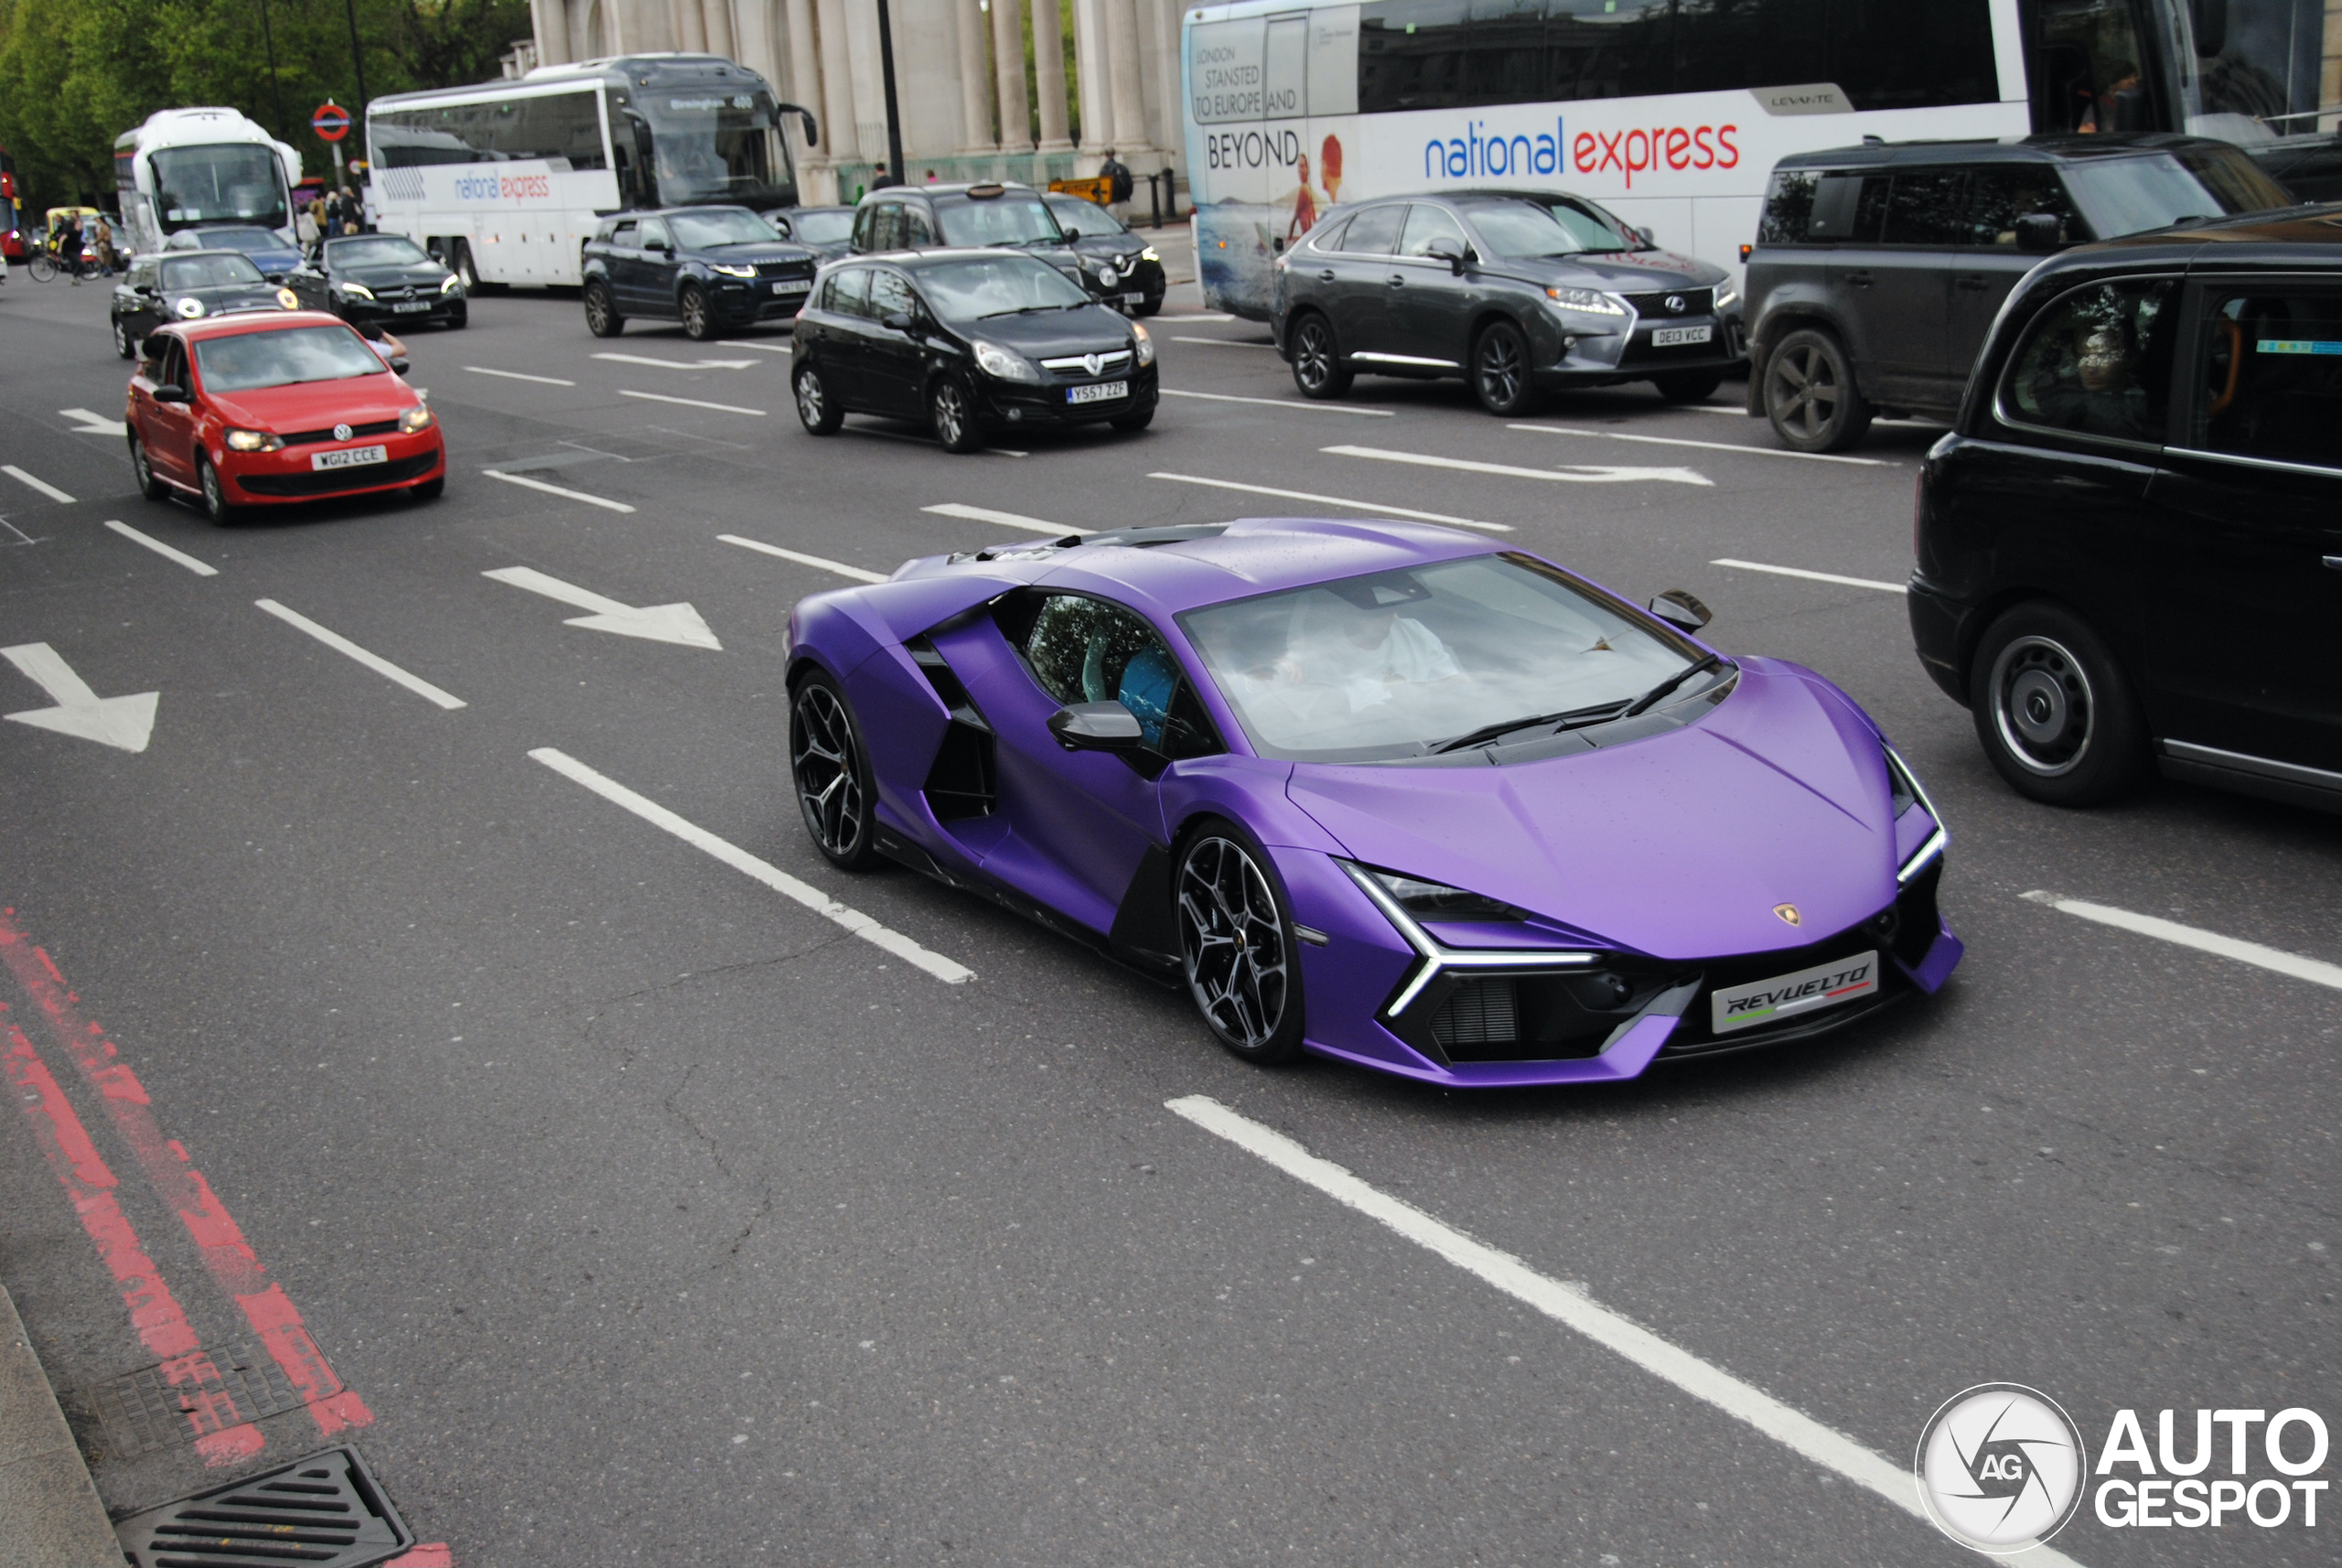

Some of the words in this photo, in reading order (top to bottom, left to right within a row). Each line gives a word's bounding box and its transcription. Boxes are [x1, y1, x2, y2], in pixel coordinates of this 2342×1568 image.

[1197, 47, 1235, 64] LONDON
[1205, 66, 1259, 89] STANSTED
[1196, 95, 1210, 116] TO
[1215, 91, 1261, 115] EUROPE
[1266, 89, 1295, 113] AND
[1771, 93, 1833, 106] LEVANTE
[1209, 130, 1299, 169] BEYOND
[1425, 115, 1563, 177] national
[1574, 124, 1739, 189] express
[500, 175, 549, 207] express
[1659, 330, 1681, 343] DE13
[1685, 328, 1704, 341] VCC
[1074, 385, 1102, 401] YS57
[1105, 382, 1124, 397] ZZF
[320, 451, 349, 467] WG12
[352, 447, 379, 463] CCE
[1727, 962, 1870, 1014] REVUELTO
